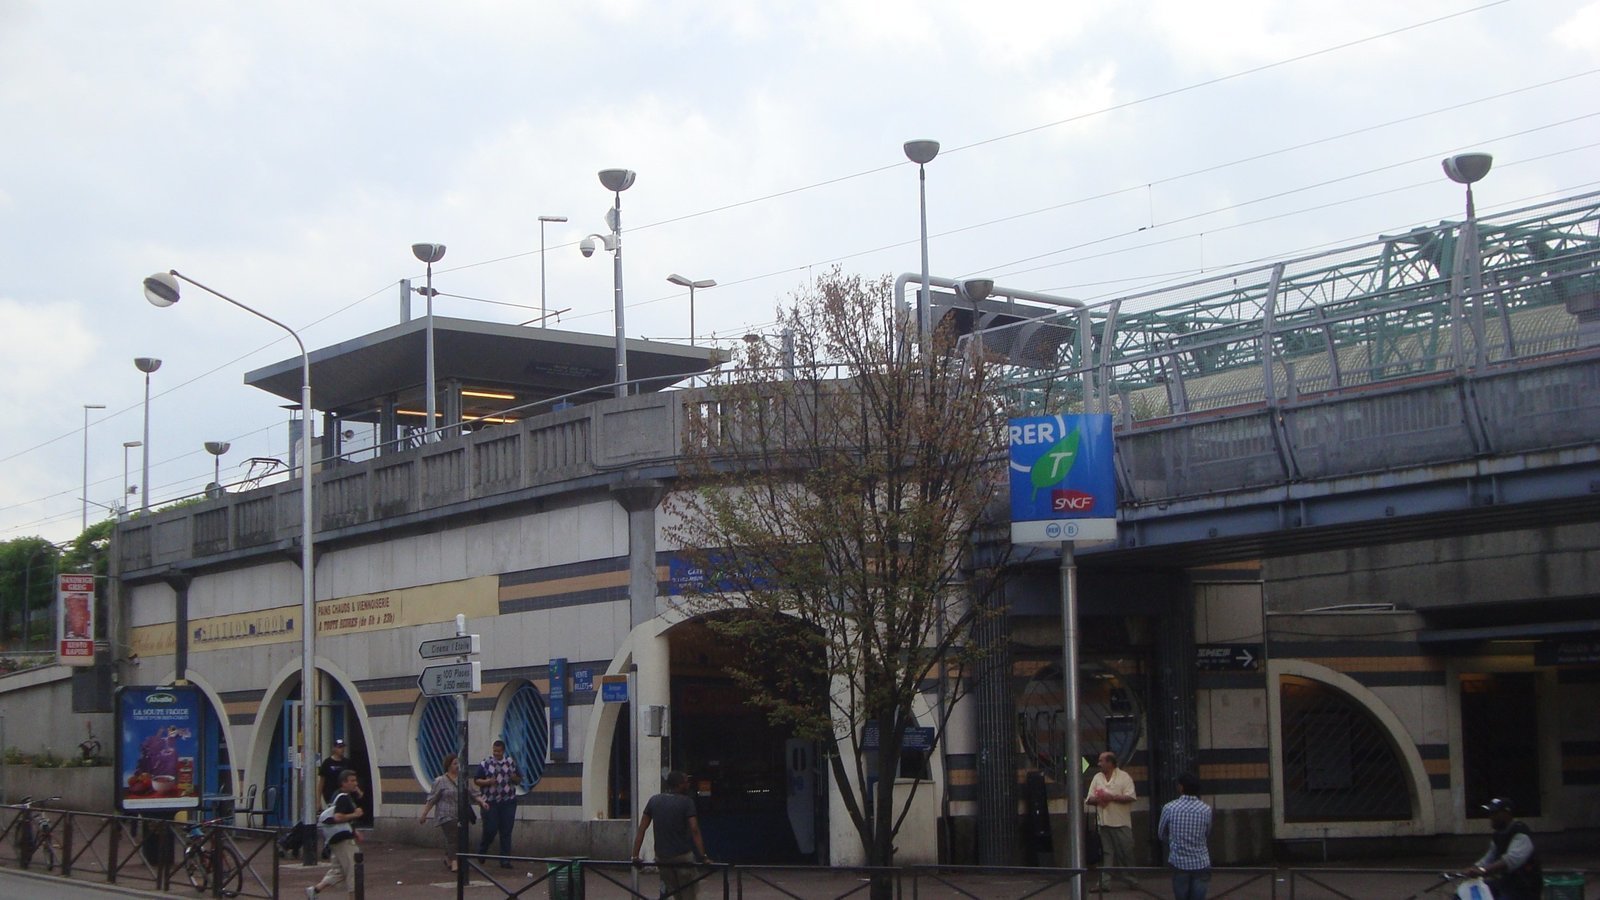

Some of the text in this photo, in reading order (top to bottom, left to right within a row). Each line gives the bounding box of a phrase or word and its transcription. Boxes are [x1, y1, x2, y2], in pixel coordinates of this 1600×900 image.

[1009, 423, 1054, 446] RER
[1050, 452, 1073, 478] T
[1054, 497, 1092, 510] SNCF
[318, 605, 331, 616] PAINS
[332, 602, 350, 615] CHAUDS
[357, 597, 390, 612] VIENNOISERIE
[133, 708, 143, 716] LA
